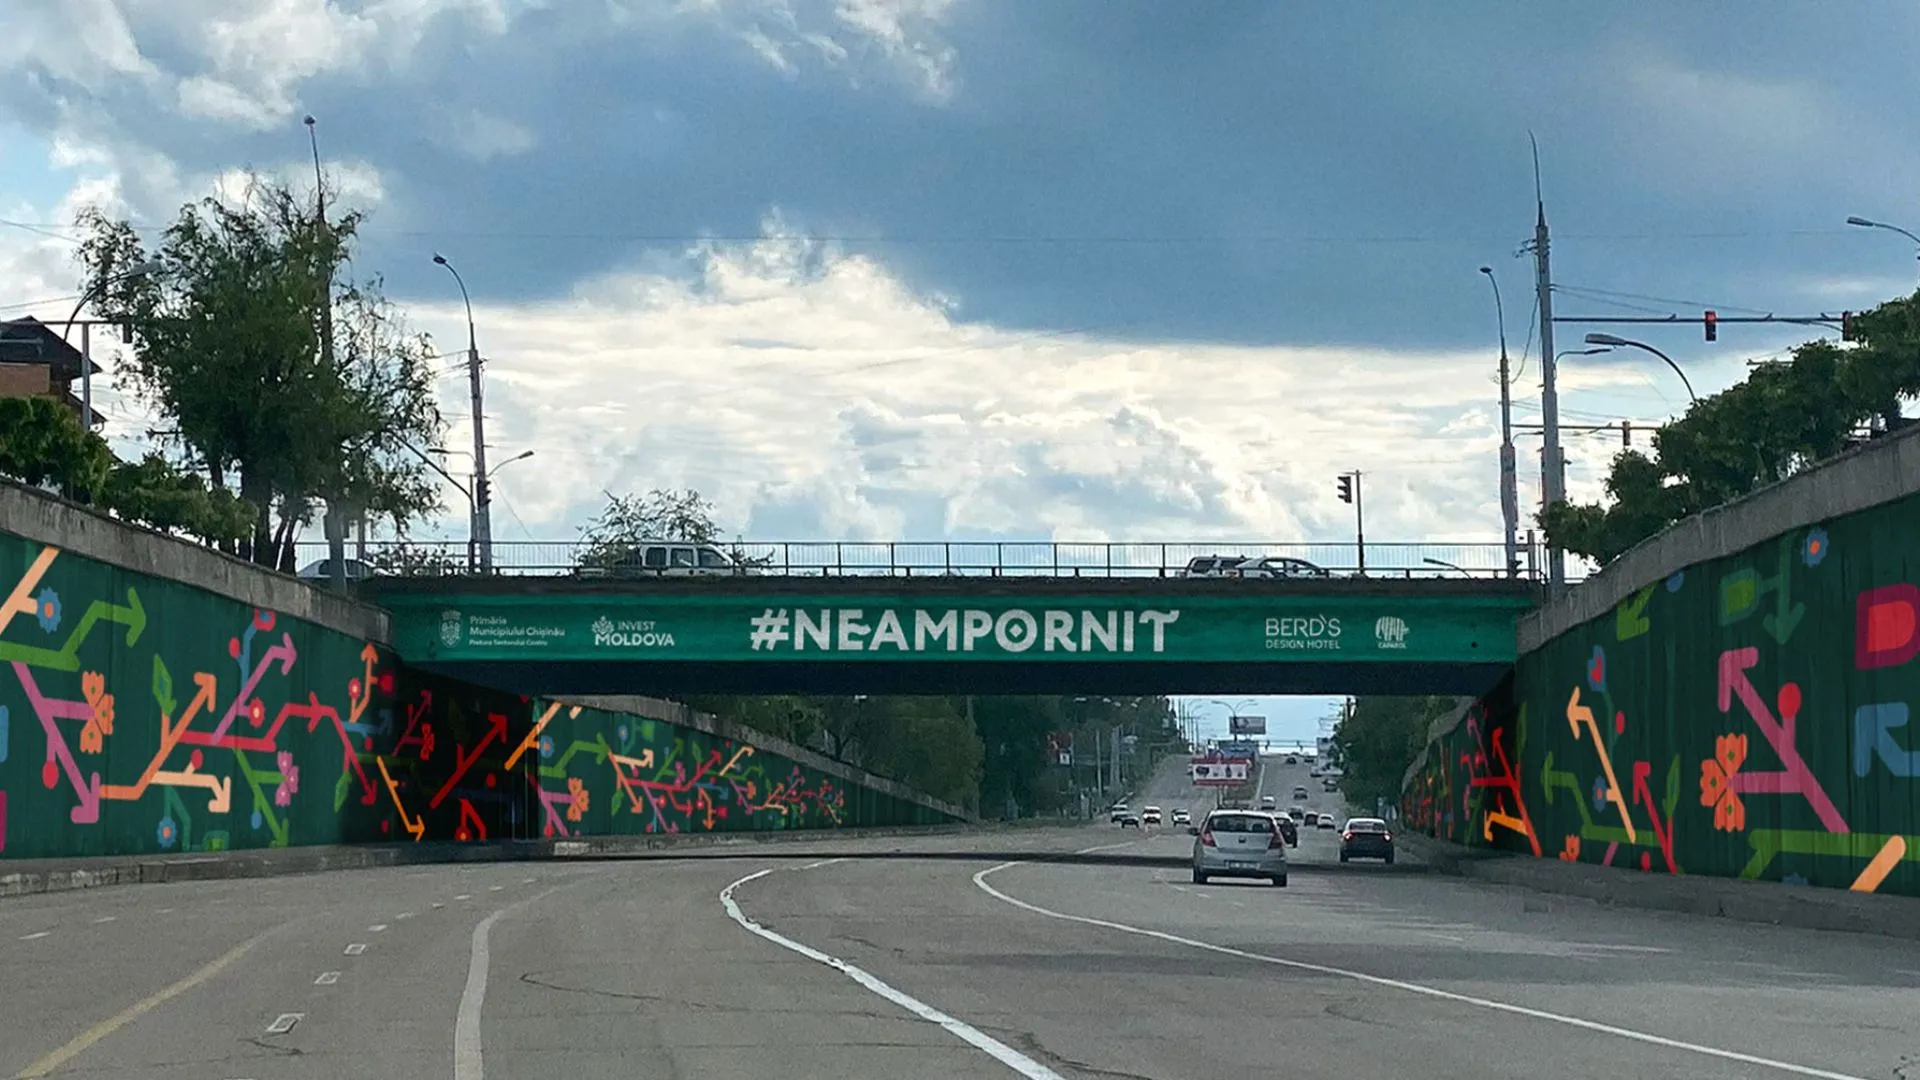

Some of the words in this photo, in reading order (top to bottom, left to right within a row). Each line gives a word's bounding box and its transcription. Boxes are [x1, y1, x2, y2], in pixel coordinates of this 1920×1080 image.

[617, 620, 656, 630] INVEST
[750, 608, 1180, 652] #NEAMPORNIT
[1265, 614, 1342, 637] BERD'S
[469, 626, 525, 638] Municipiului
[595, 632, 675, 646] MOLDOVA
[1265, 639, 1304, 649] DESIGN
[1307, 639, 1341, 649] HOTEL
